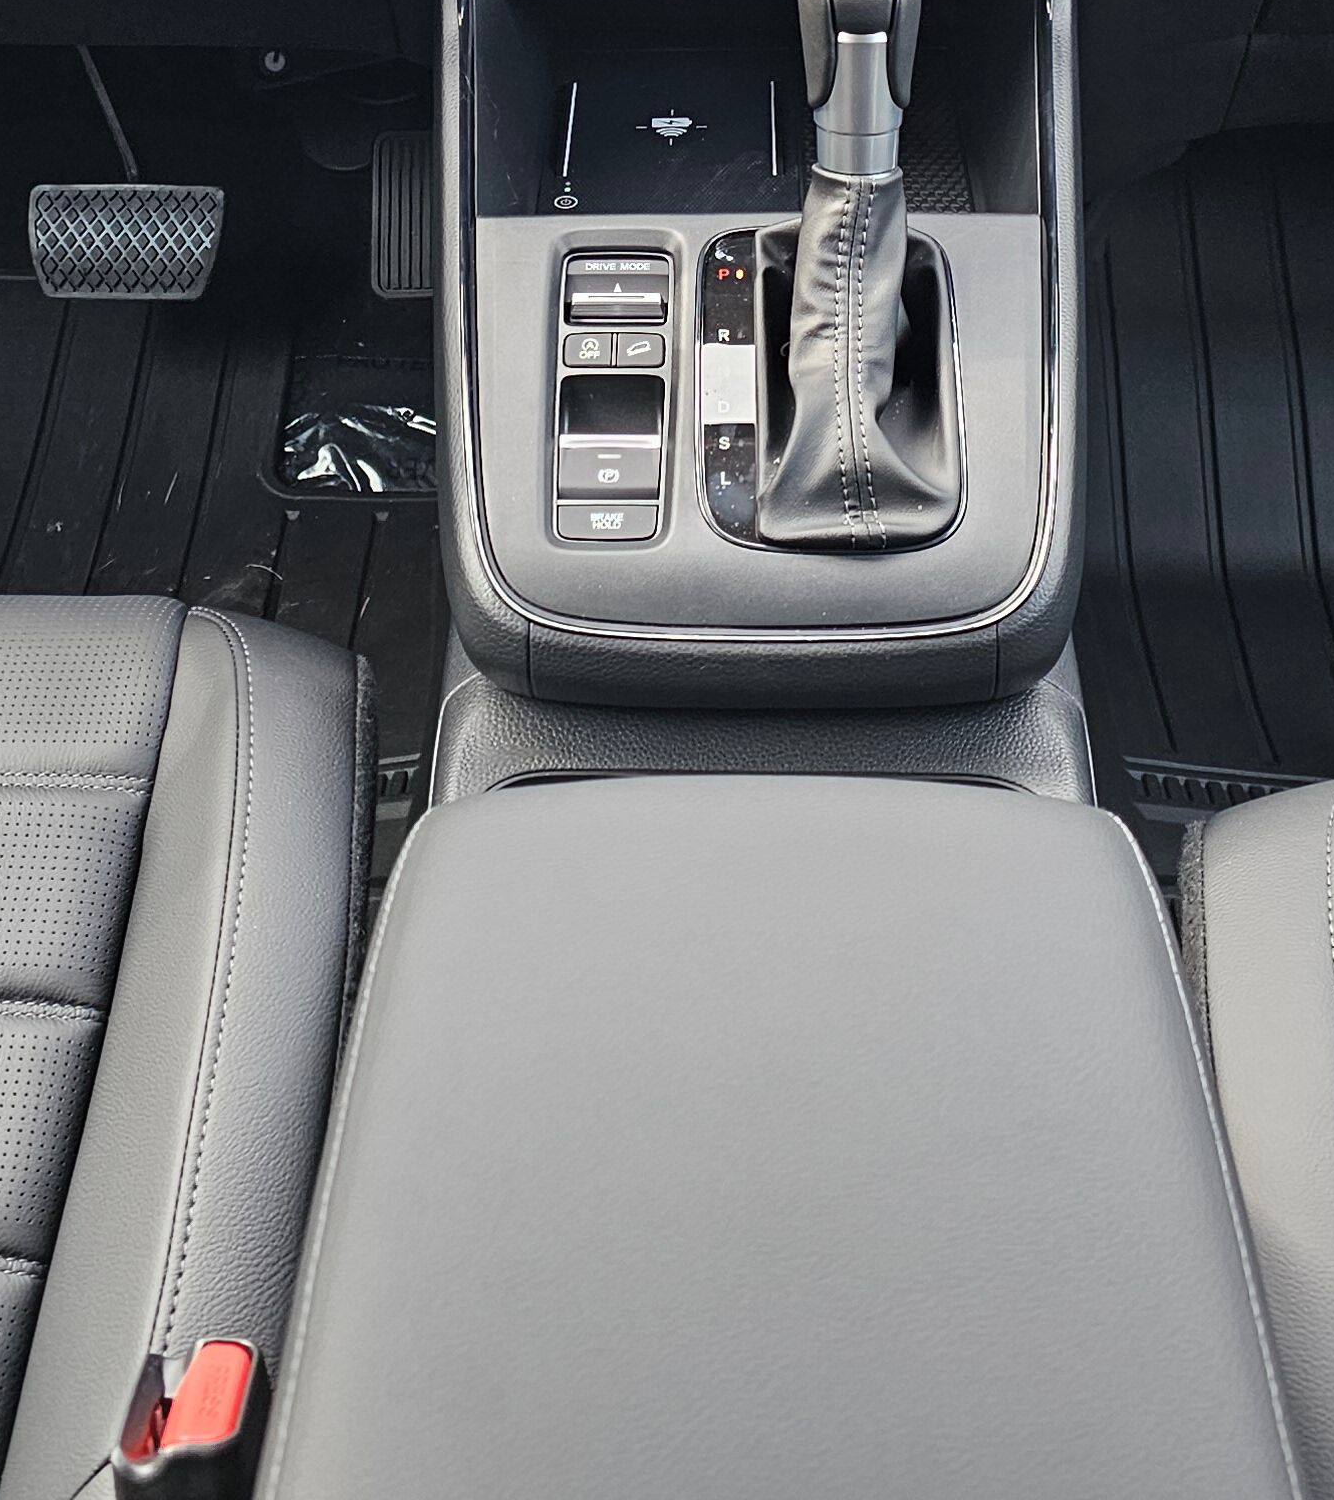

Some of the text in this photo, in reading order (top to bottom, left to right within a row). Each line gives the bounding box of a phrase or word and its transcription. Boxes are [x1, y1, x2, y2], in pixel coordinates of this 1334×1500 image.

[585, 262, 651, 271] DRIVE MODE
[718, 269, 730, 280] P
[718, 329, 730, 342] R
[579, 350, 601, 359] OFF
[717, 400, 730, 414] D
[718, 436, 731, 450] S
[720, 471, 731, 486] L
[590, 512, 624, 522] BRAKE
[592, 520, 622, 530] HOLD
